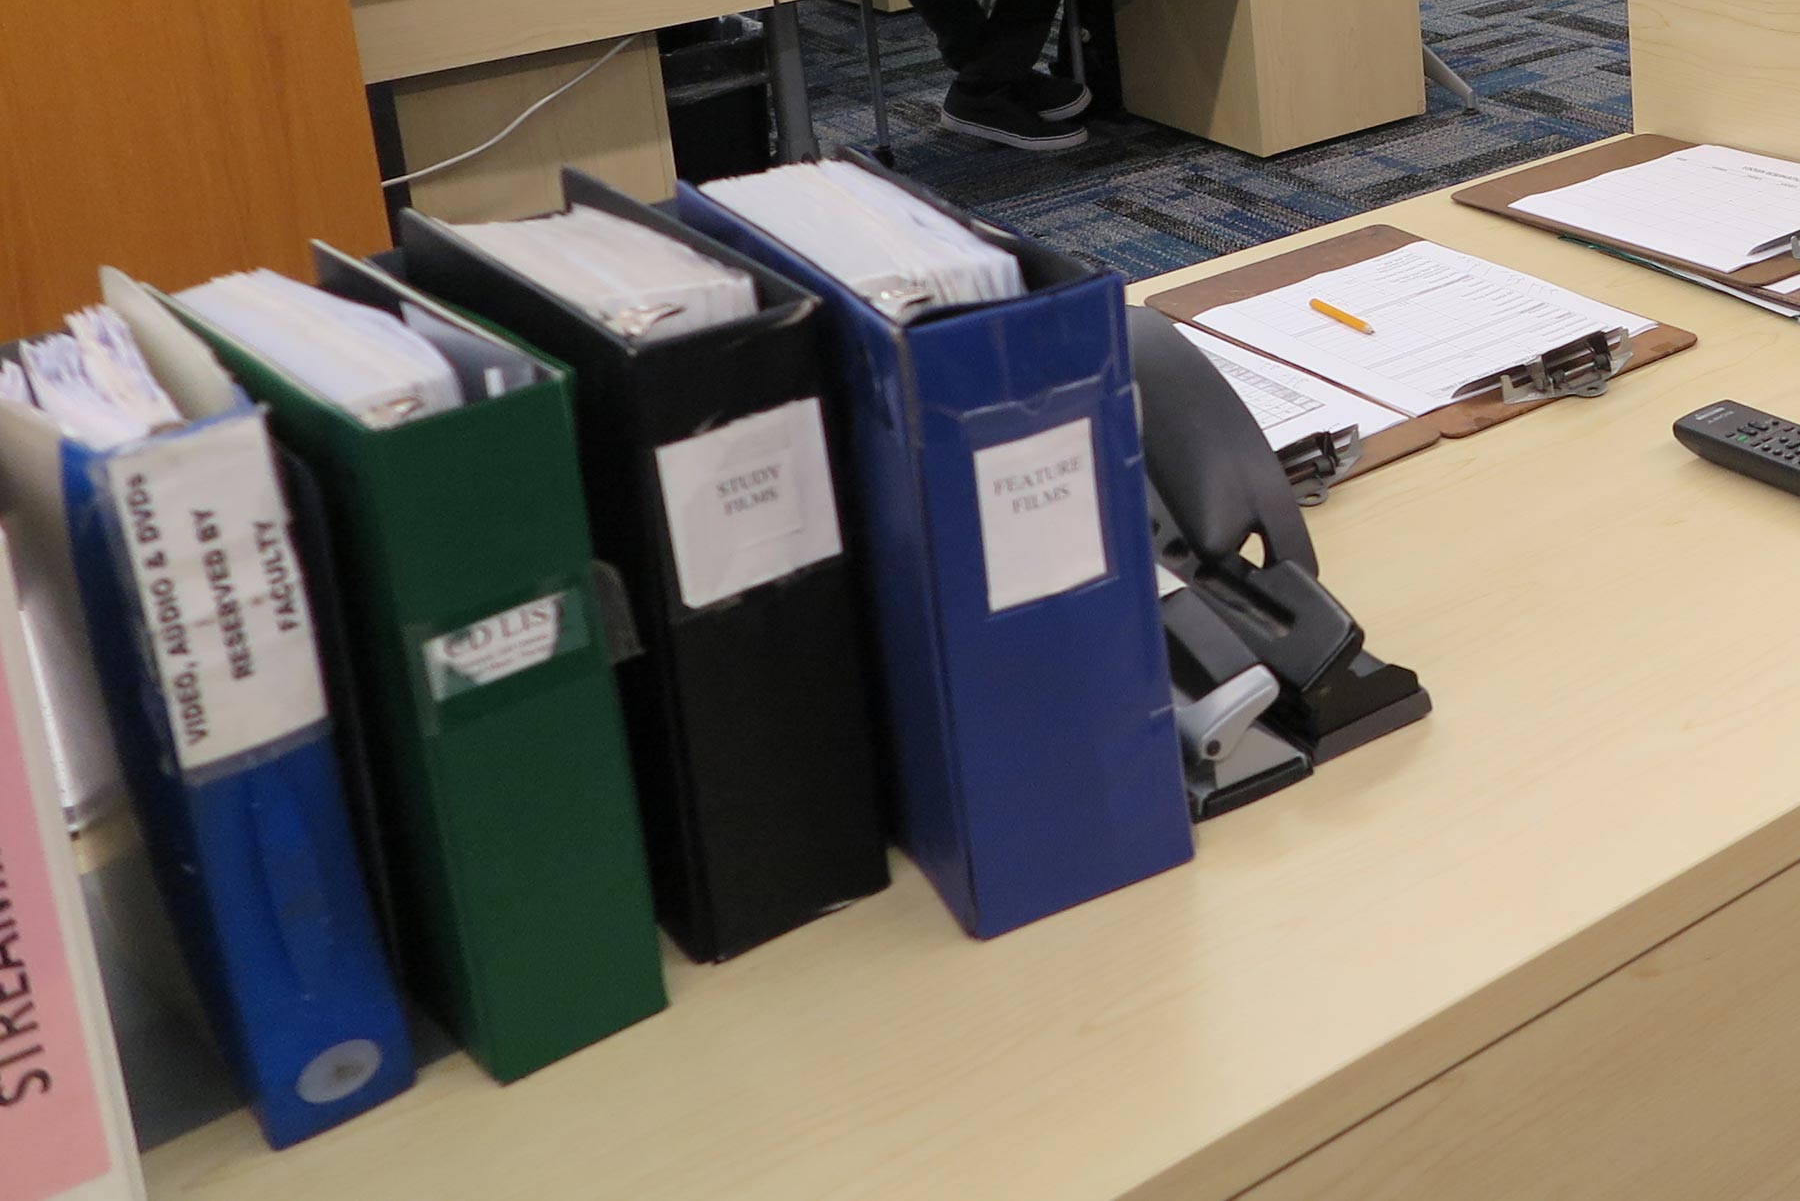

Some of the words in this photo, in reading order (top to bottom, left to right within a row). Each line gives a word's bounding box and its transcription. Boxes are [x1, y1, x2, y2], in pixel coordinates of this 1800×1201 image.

[716, 463, 782, 497] STUDY
[992, 456, 1081, 495] FEATURE
[126, 473, 161, 544] DVDs
[724, 485, 779, 516] FILMS
[1012, 483, 1070, 514] FILMS
[191, 509, 221, 543] BY
[145, 551, 168, 570] &
[253, 521, 301, 632] FACULTY
[150, 577, 190, 656] AUDIO
[203, 549, 255, 681] RESERVED
[174, 661, 209, 746] VIDEO,
